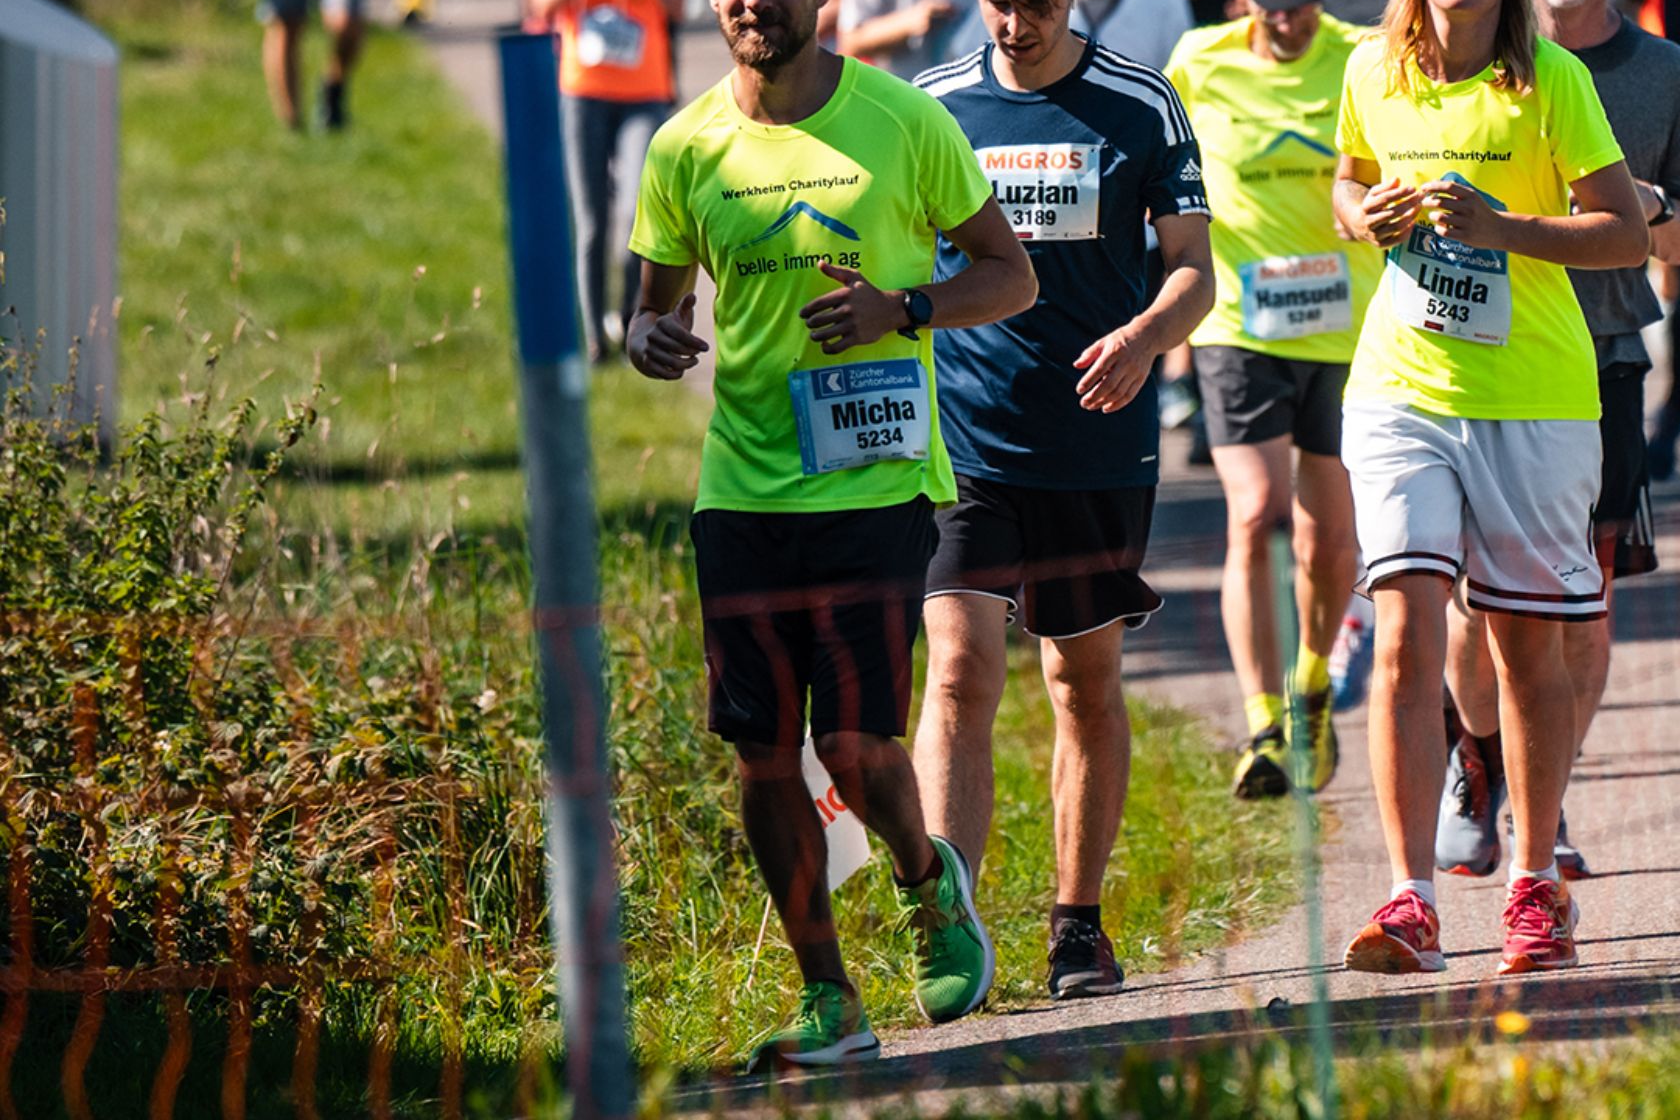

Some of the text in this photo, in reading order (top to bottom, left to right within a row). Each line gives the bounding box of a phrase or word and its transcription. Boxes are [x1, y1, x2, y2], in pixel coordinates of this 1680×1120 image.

[986, 151, 1082, 170] MIGROS
[1388, 149, 1512, 163] Werkheim Charitylauf
[721, 174, 859, 201] Werkheim Charitylauf
[991, 180, 1078, 204] Luzian
[1013, 209, 1056, 225] 3189
[736, 251, 861, 277] belle immo ag
[1418, 263, 1488, 304] Linda
[1426, 298, 1470, 322] 5243
[849, 367, 884, 379] Zürcher
[850, 374, 914, 388] Kantonalbank
[831, 396, 916, 430] Micha
[856, 427, 904, 449] 5234
